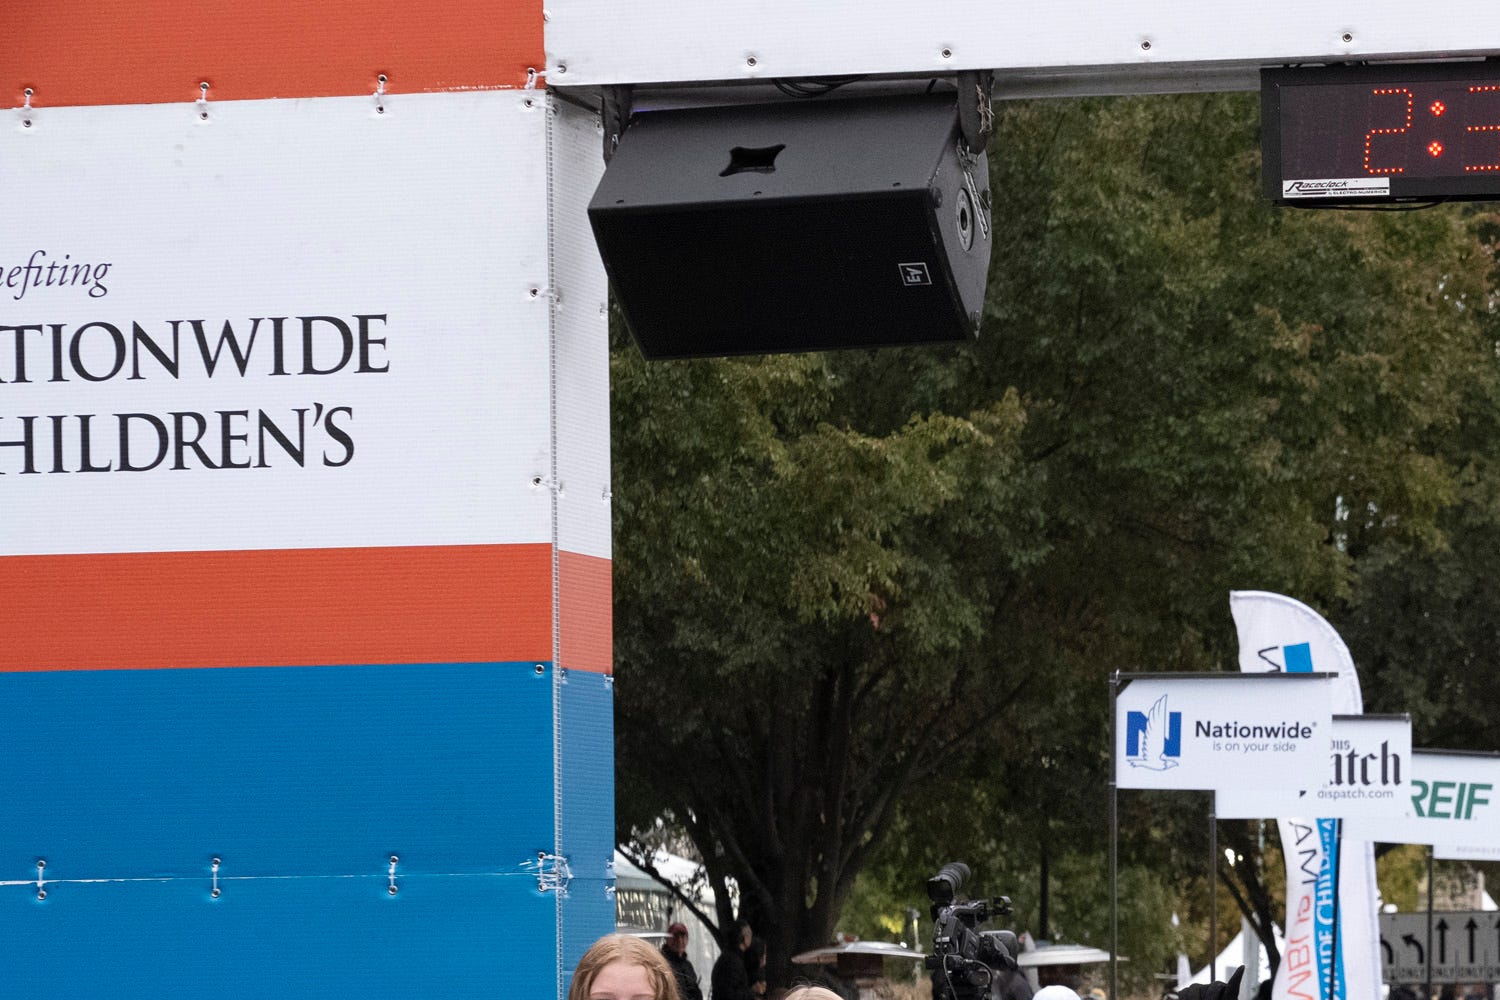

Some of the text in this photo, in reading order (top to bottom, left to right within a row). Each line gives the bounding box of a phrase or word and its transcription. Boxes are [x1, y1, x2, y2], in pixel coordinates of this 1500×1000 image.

[1195, 720, 1313, 739] Nationwide
[1213, 741, 1296, 754] is on your side
[1317, 788, 1394, 801] dispatch.com
